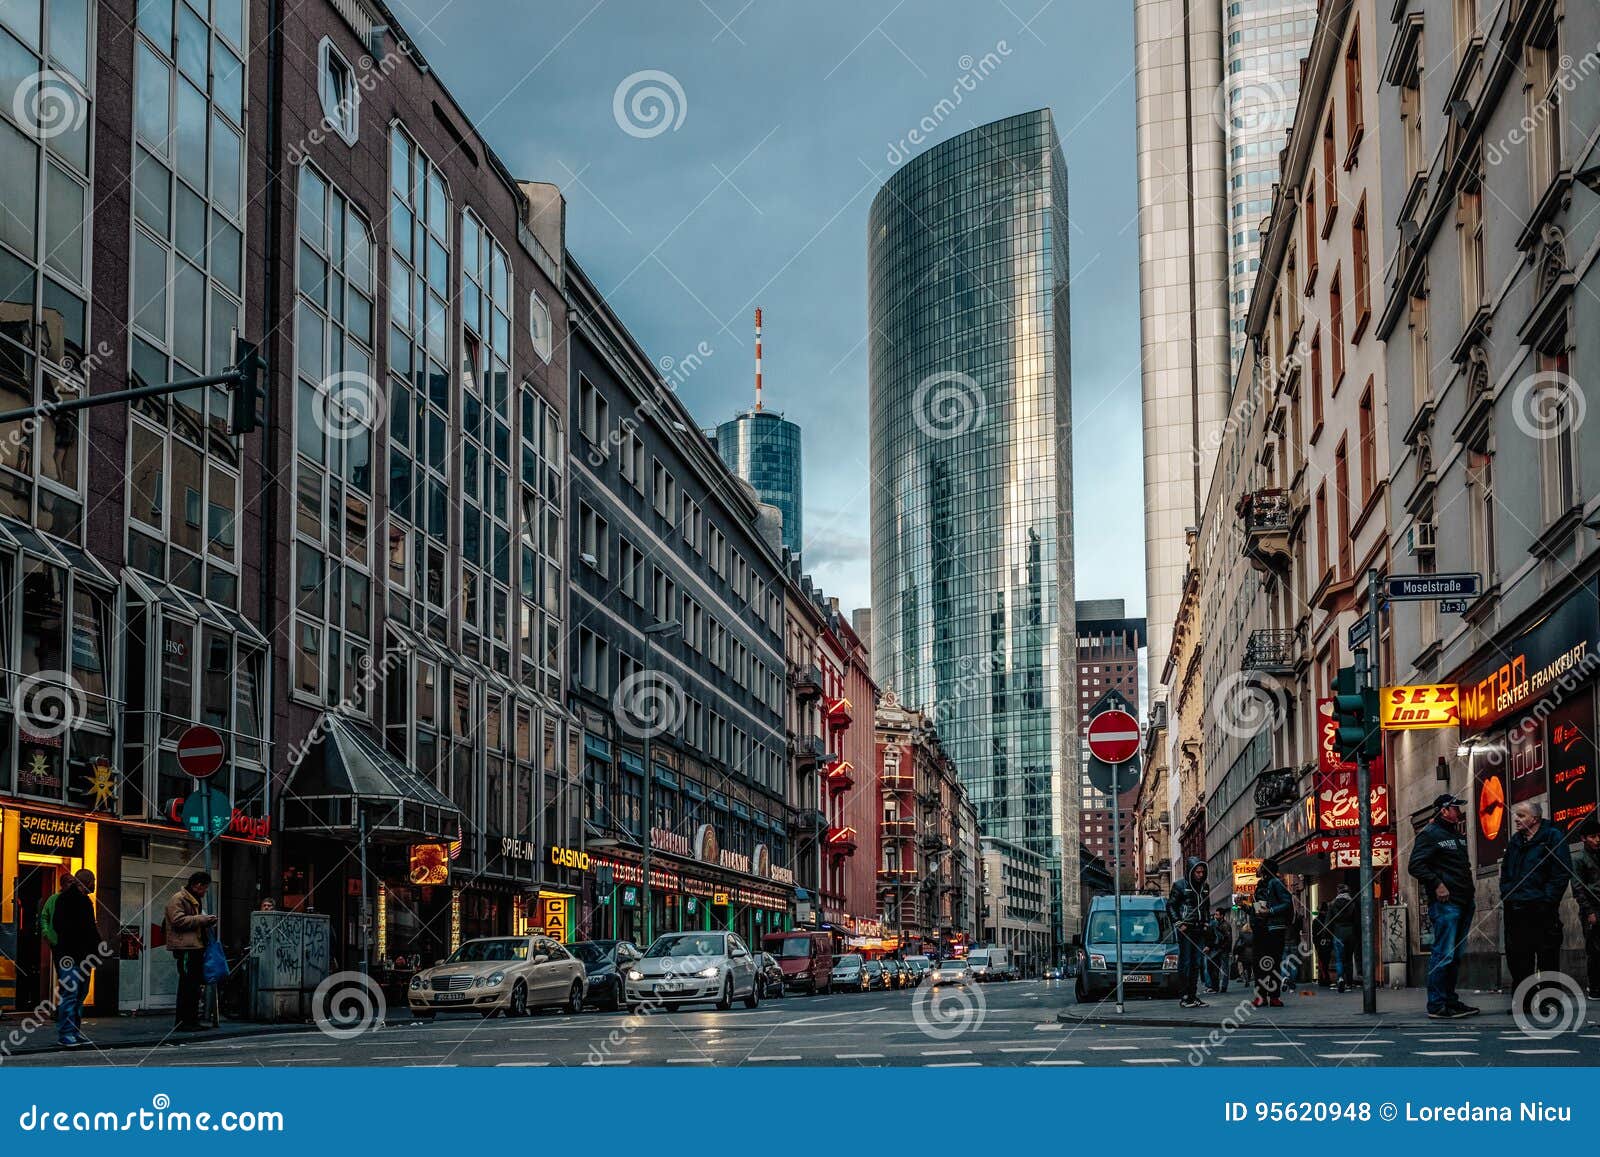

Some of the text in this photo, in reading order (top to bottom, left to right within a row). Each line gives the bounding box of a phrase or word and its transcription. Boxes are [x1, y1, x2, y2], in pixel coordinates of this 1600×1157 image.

[1403, 580, 1461, 593] Moselstraße
[165, 639, 184, 656] HSC
[1497, 640, 1587, 712] CENTER FRANKFURT
[1392, 686, 1456, 704] SEX
[1392, 707, 1430, 720] Inn
[1332, 788, 1380, 817] Ers
[23, 816, 81, 834] SPIELHALLE
[230, 808, 271, 839] Royal
[1335, 818, 1360, 827] EINGA
[30, 833, 75, 848] EINGANG
[1332, 840, 1350, 849] Eros
[1373, 837, 1392, 847] Eros
[502, 837, 534, 861] SPIEL-IN
[552, 846, 589, 870] CASINO
[549, 901, 562, 941] CAS
